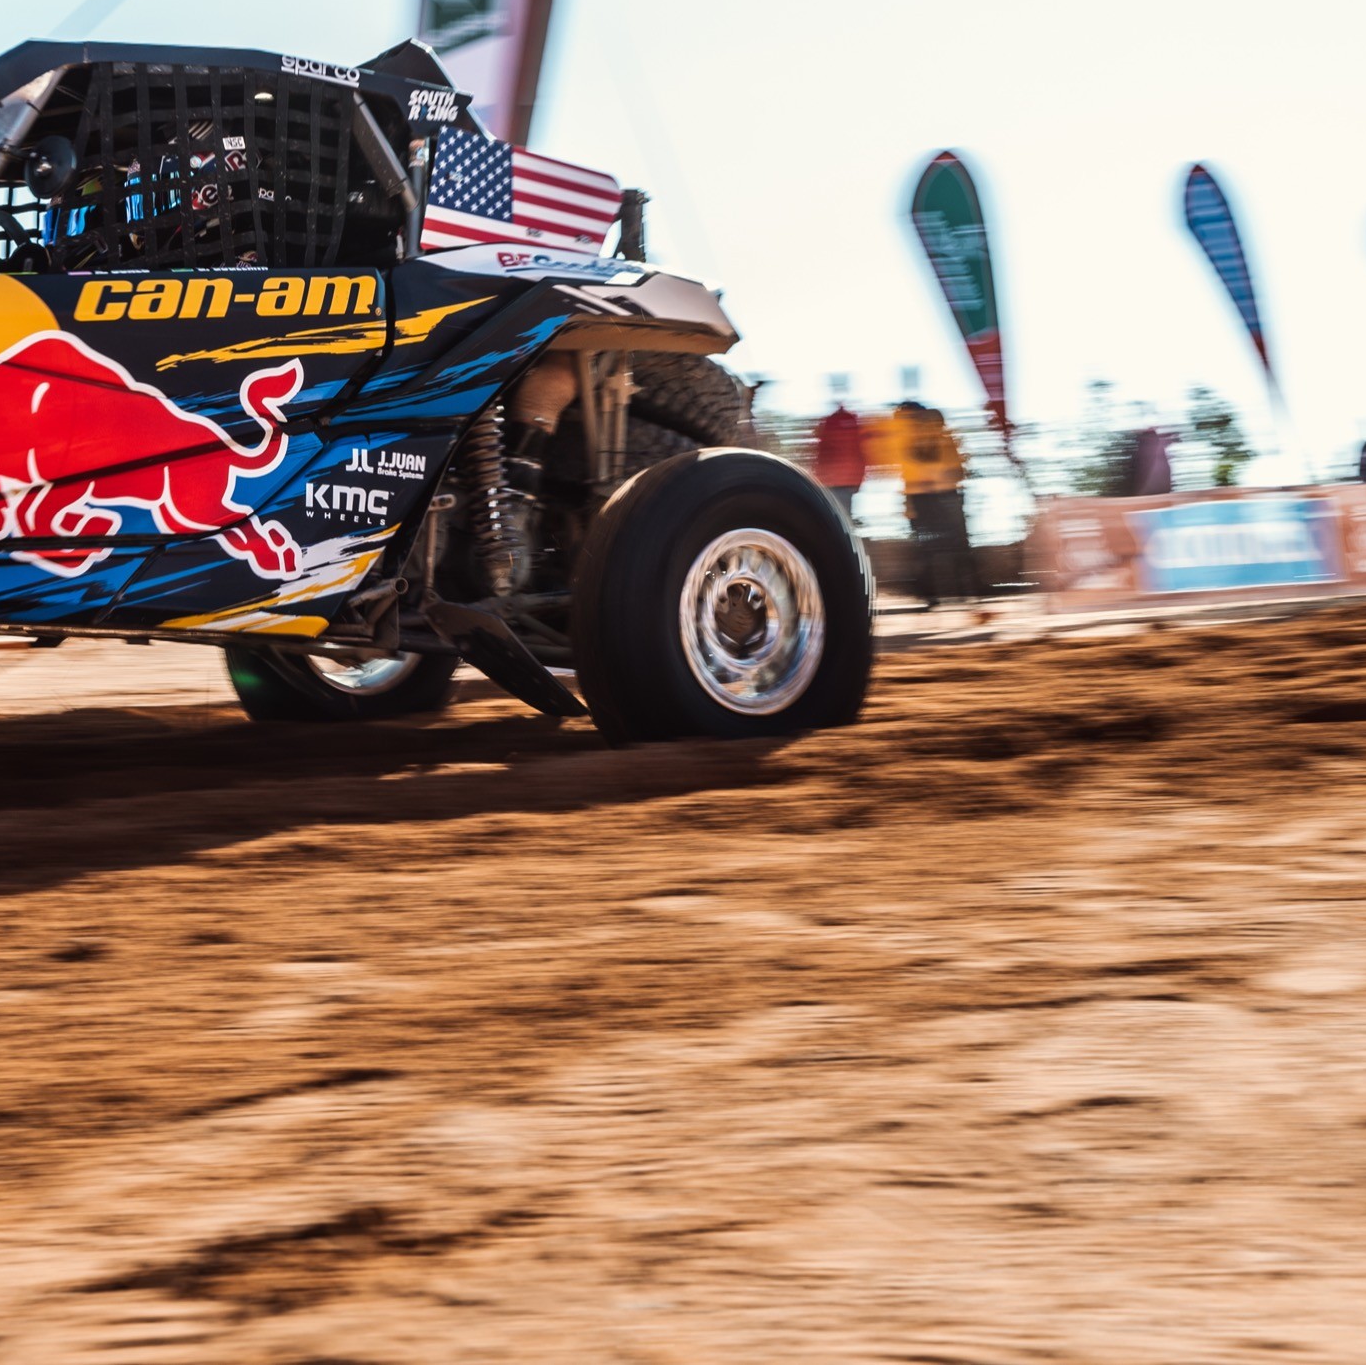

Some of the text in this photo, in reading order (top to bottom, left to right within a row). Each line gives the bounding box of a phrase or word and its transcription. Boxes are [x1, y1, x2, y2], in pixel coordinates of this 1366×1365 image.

[408, 90, 456, 106] SOUTH
[74, 275, 377, 322] can-am
[378, 451, 426, 472] J.JUAN
[377, 467, 424, 480] Brake Systems
[306, 510, 386, 526] WHEELS
